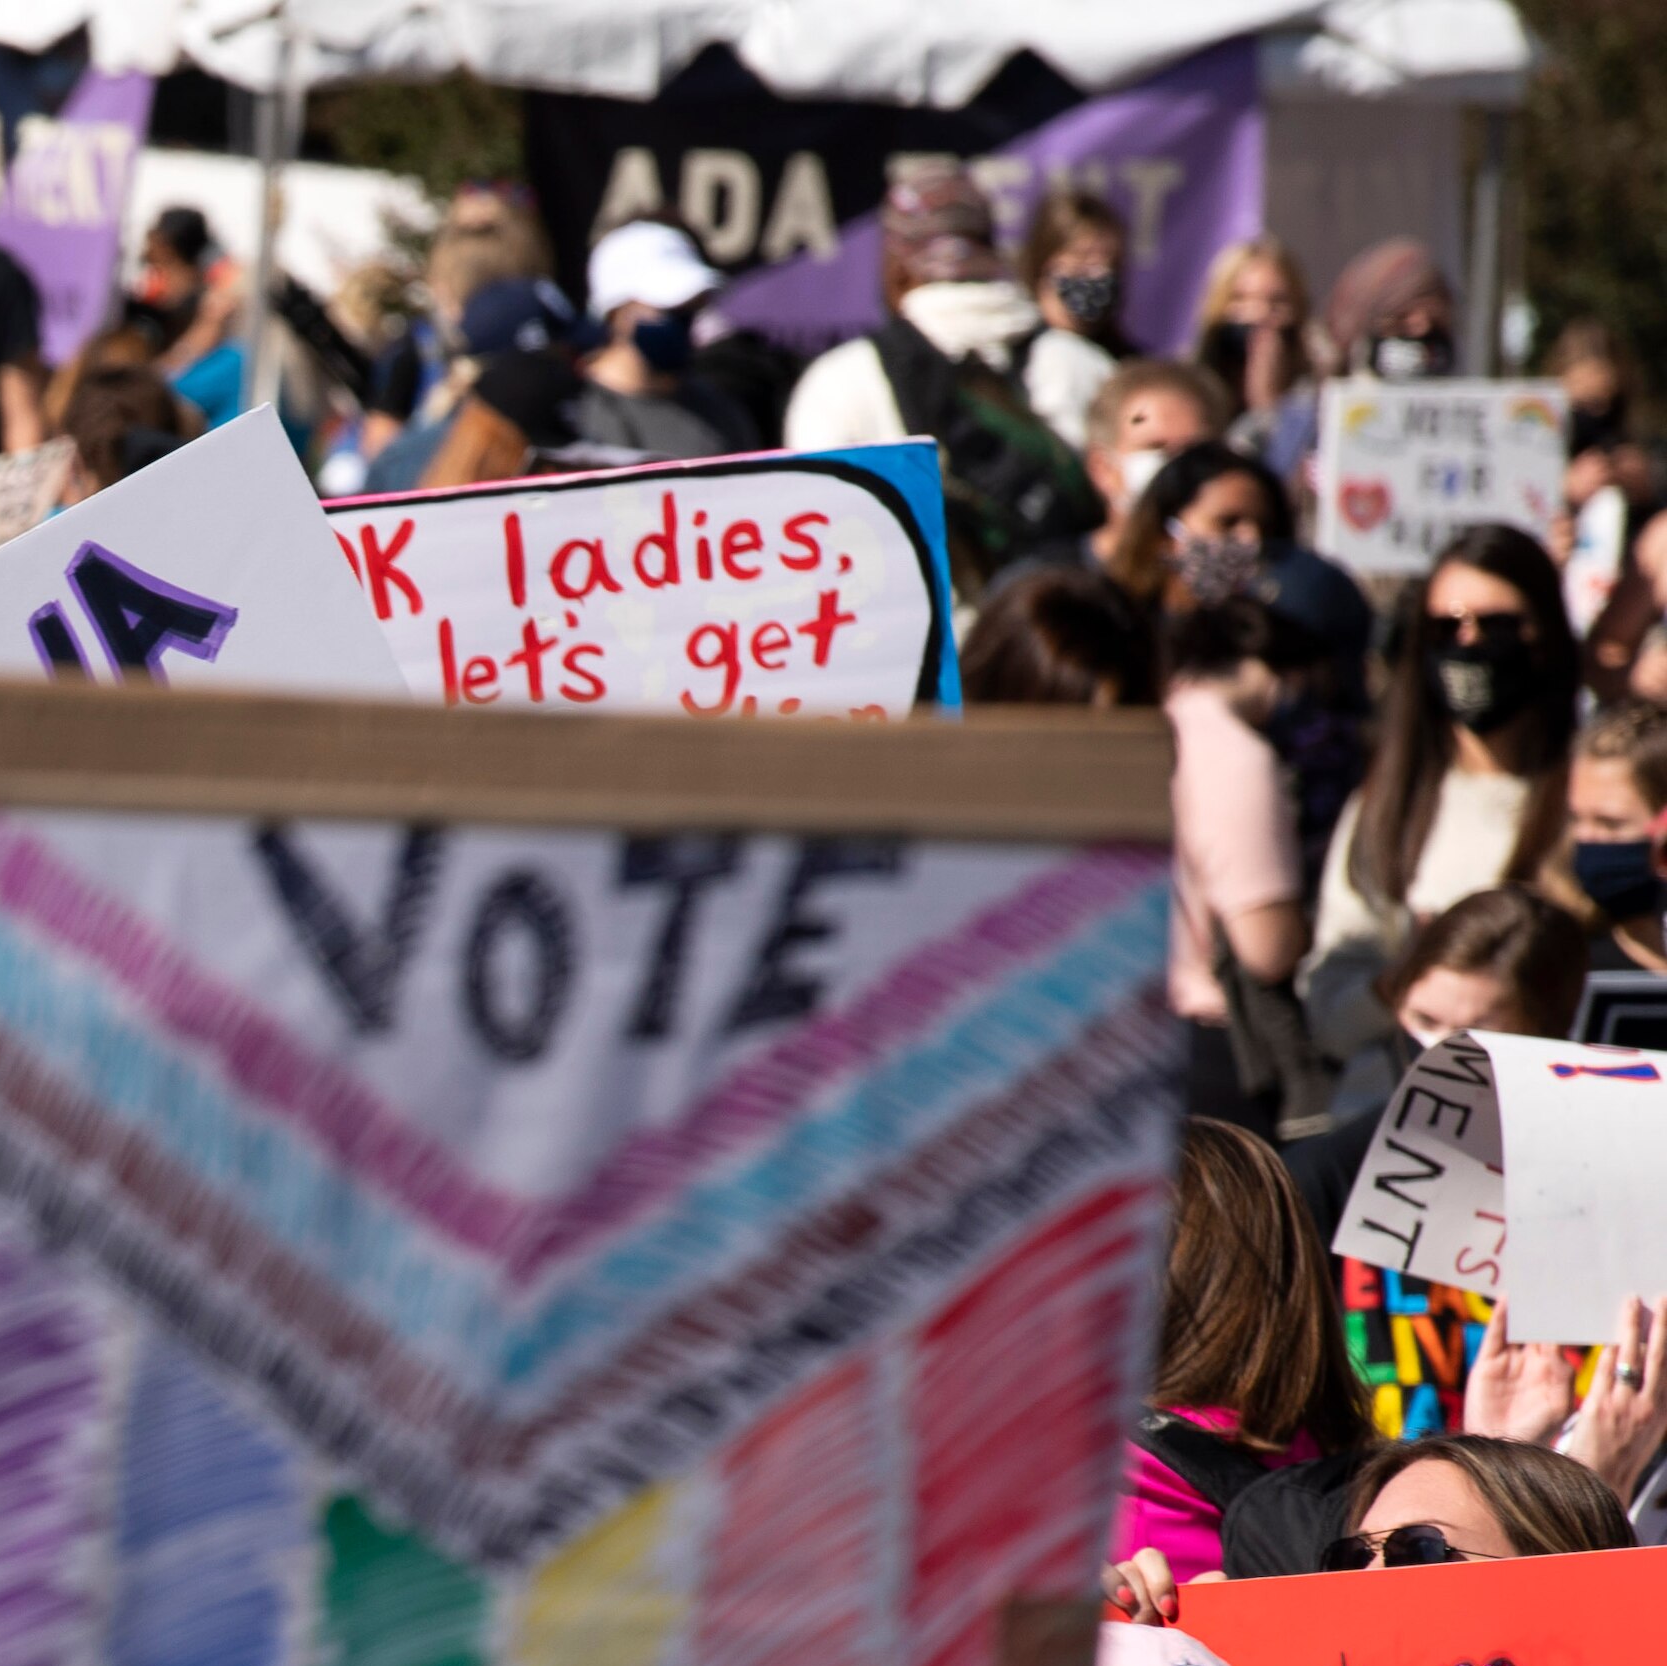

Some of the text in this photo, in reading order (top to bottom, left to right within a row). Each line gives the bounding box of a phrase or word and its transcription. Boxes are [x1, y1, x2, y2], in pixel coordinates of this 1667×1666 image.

[592, 146, 842, 263] ADA
[334, 518, 423, 620] K
[505, 491, 853, 608] ladies,
[439, 588, 856, 720] let's get
[255, 820, 909, 1061] VOTE
